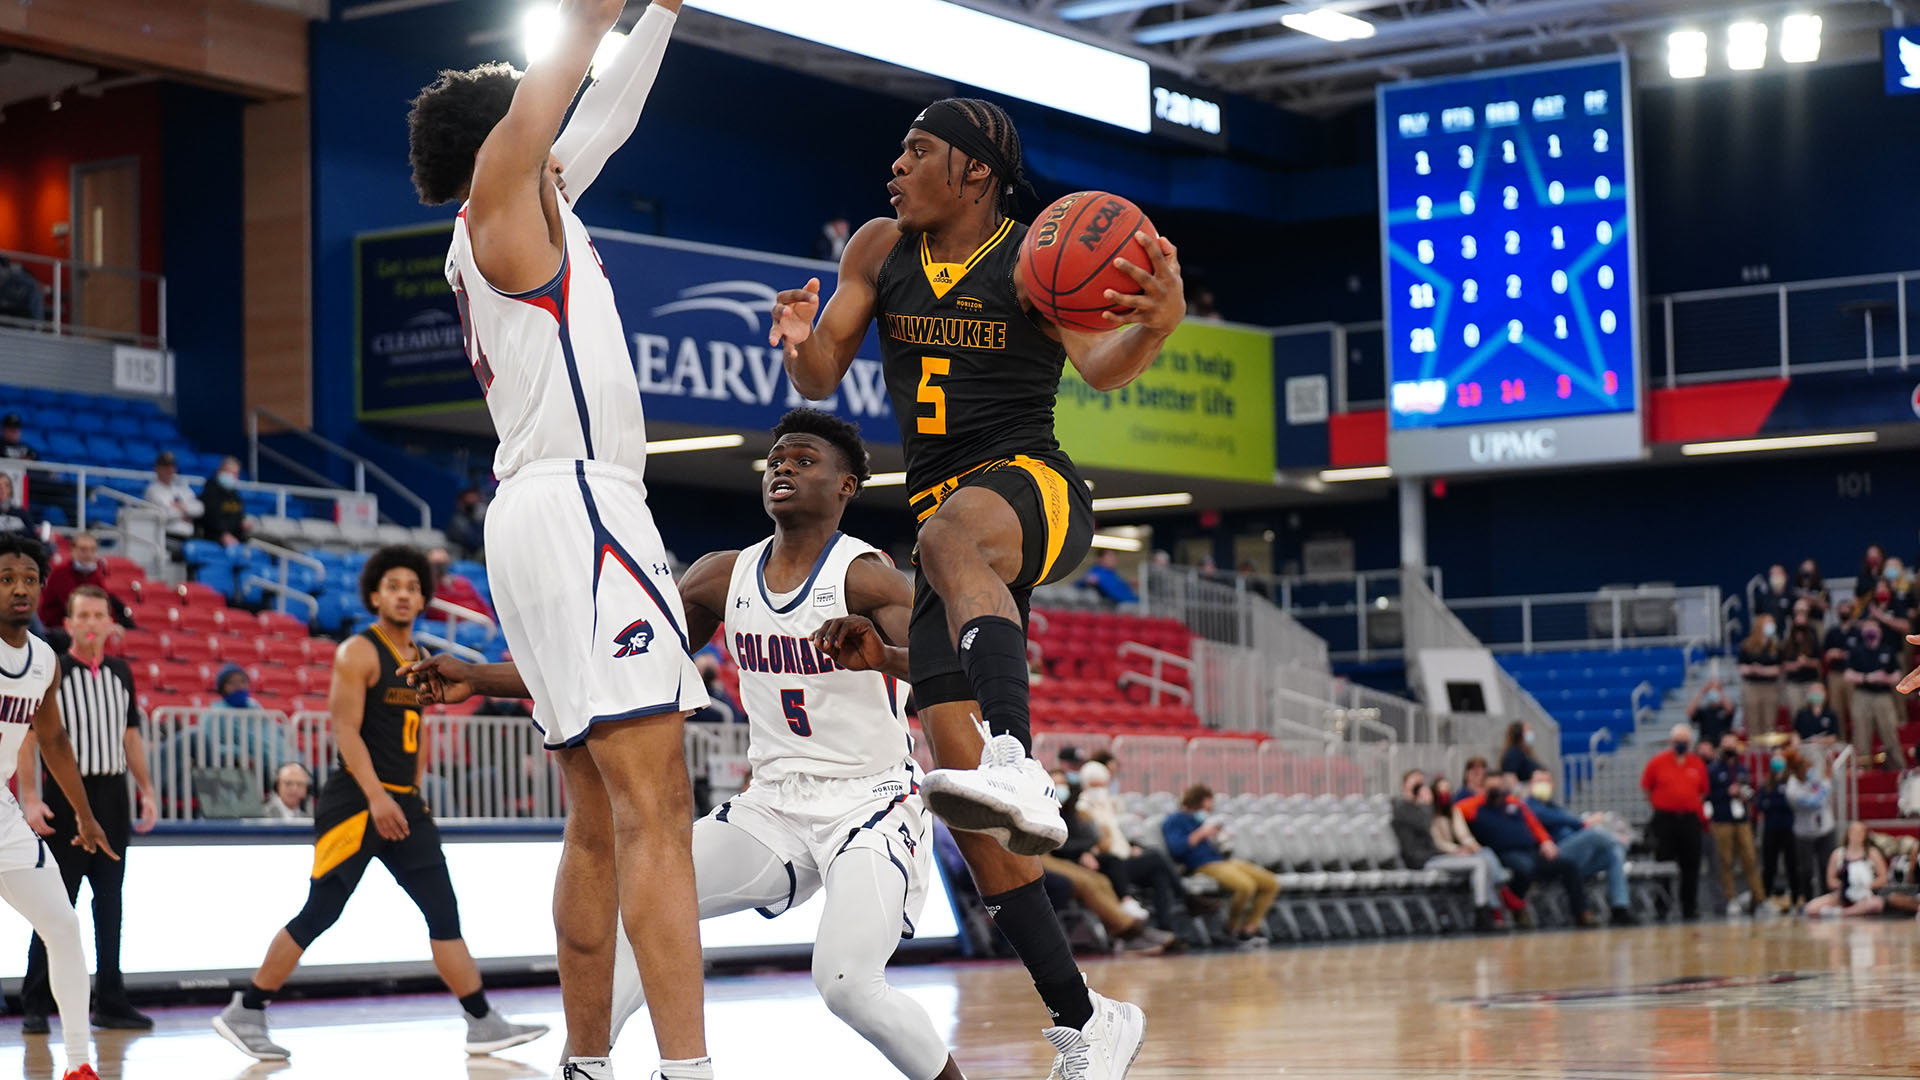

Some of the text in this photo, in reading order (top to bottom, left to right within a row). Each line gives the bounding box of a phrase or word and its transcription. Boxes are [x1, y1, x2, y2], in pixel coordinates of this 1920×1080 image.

[1415, 151, 1431, 175] 1
[1502, 140, 1516, 163] 1
[1548, 134, 1562, 158] 1
[1593, 128, 1608, 152] 2
[1503, 186, 1518, 210] 2
[1548, 180, 1565, 205] 0
[1594, 175, 1611, 200] 0
[1079, 200, 1127, 252] NCAA
[1504, 230, 1520, 254] 2
[1551, 225, 1565, 250] 1
[1596, 220, 1612, 245] 0
[933, 276, 953, 284] adidas
[1462, 278, 1478, 303] 2
[1506, 274, 1522, 298] 2
[1551, 269, 1568, 294] 0
[1597, 265, 1614, 289] 0
[956, 300, 983, 309] HORIZON
[885, 313, 1006, 349] MILWAUKEE
[1463, 323, 1480, 348] 0
[1507, 319, 1523, 343] 2
[1554, 314, 1568, 339] 1
[1600, 309, 1616, 334] 0
[917, 356, 950, 435] 5
[1137, 382, 1197, 412] better
[1470, 428, 1556, 463] UPMC
[1837, 472, 1872, 497] 101
[735, 632, 846, 675] COLONIAL
[780, 688, 812, 737] 5
[402, 709, 420, 754] 0
[872, 784, 903, 794] HORIZON
